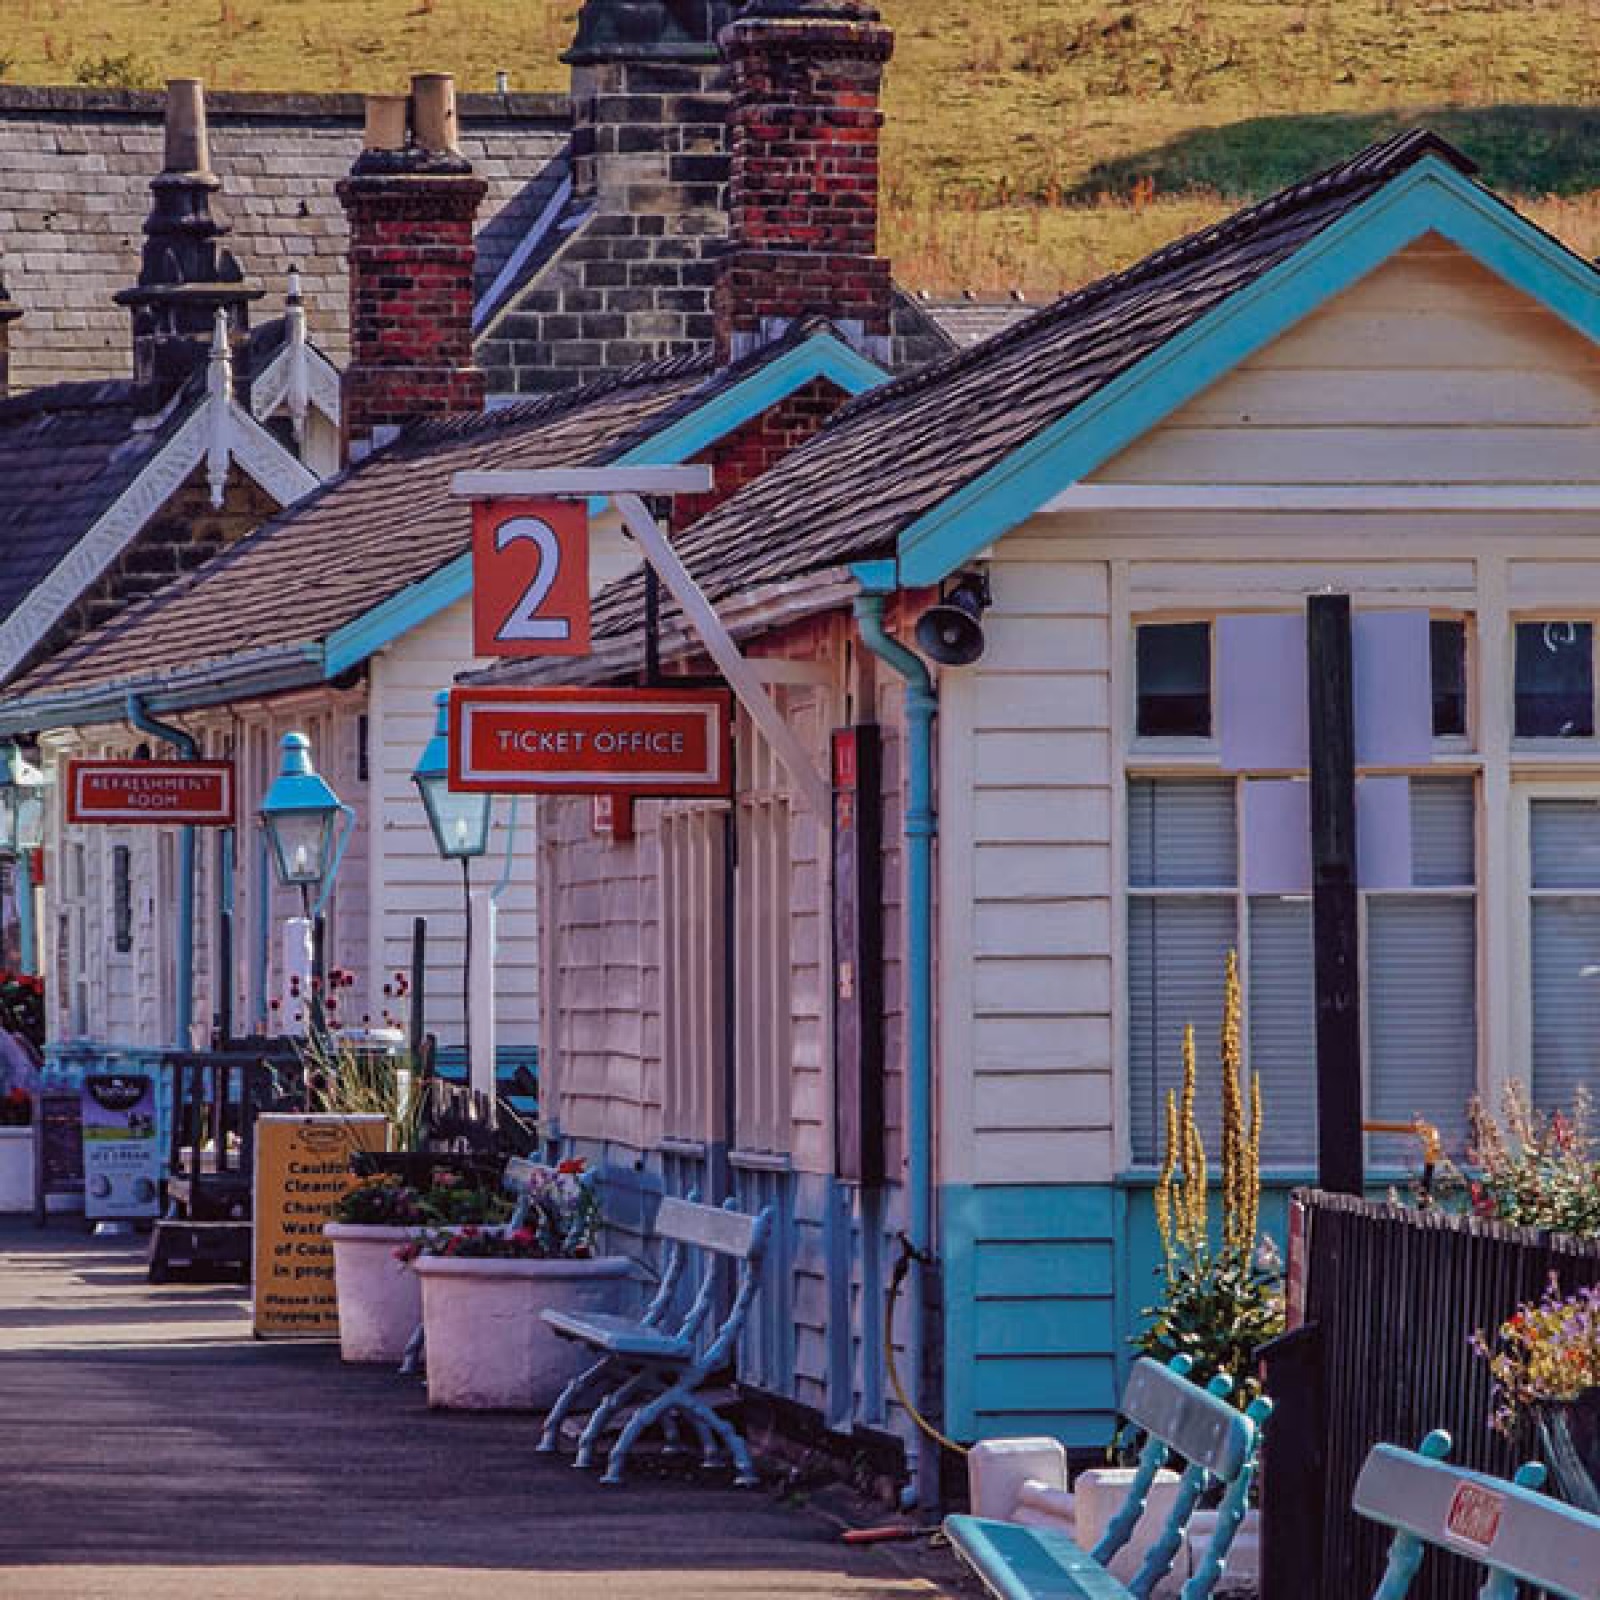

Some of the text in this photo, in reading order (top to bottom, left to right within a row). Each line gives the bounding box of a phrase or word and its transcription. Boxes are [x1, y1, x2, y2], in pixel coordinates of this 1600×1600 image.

[494, 514, 571, 641] 2
[496, 730, 684, 753] TICKET OFFICE
[128, 794, 178, 806] ROOM
